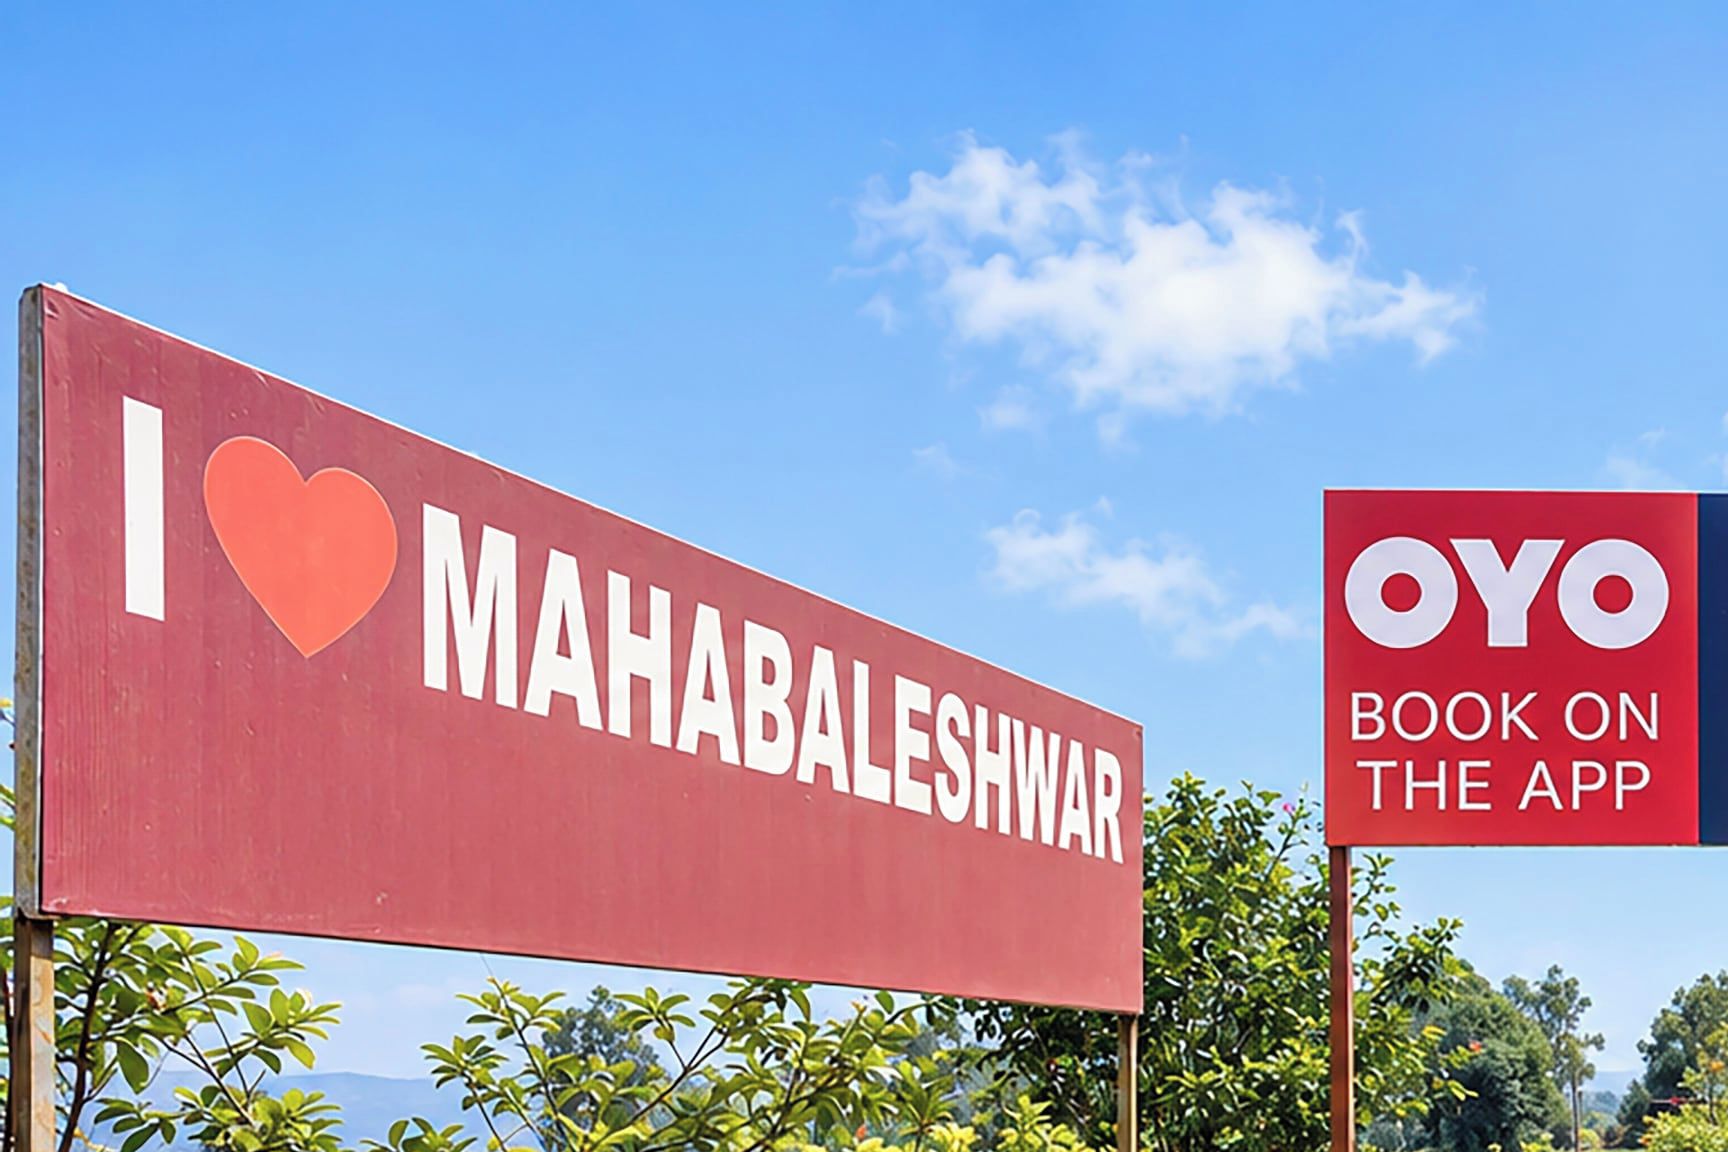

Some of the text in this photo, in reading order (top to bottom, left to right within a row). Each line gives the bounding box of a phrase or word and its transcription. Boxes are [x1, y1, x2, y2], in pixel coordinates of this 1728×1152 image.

[123, 396, 1125, 865] I MAHABALESHWAR
[1345, 536, 1670, 650] OYO
[1351, 691, 1658, 742] BOOK ON
[1356, 760, 1651, 811] THE APP
